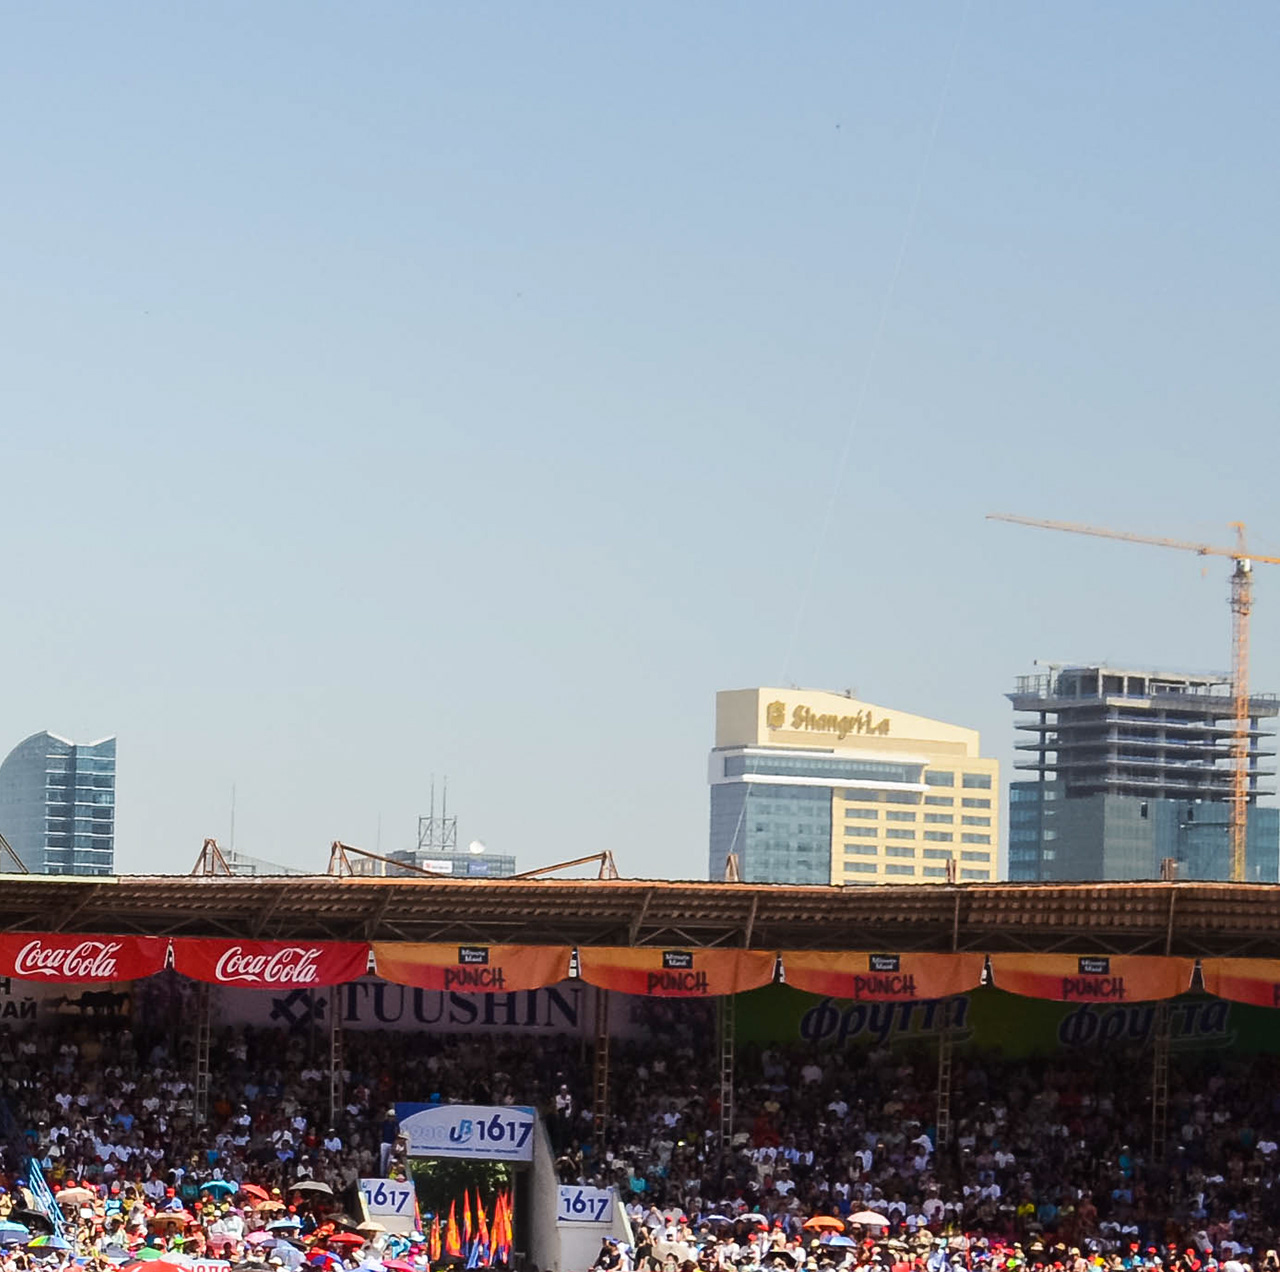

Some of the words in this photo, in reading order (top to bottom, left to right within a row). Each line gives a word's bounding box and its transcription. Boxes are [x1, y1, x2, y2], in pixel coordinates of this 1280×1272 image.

[15, 940, 122, 976] Coca-Cola
[216, 946, 323, 982] Coca-Cola
[444, 967, 506, 990] PUNCH
[647, 971, 709, 994] PUNCH
[854, 974, 917, 1001] PUNCH
[1062, 976, 1126, 1000] PUNCH
[344, 982, 582, 1028] TUUSHIN
[475, 1114, 533, 1148] 1617
[365, 1182, 410, 1213] 1617
[563, 1190, 610, 1221] 1617
